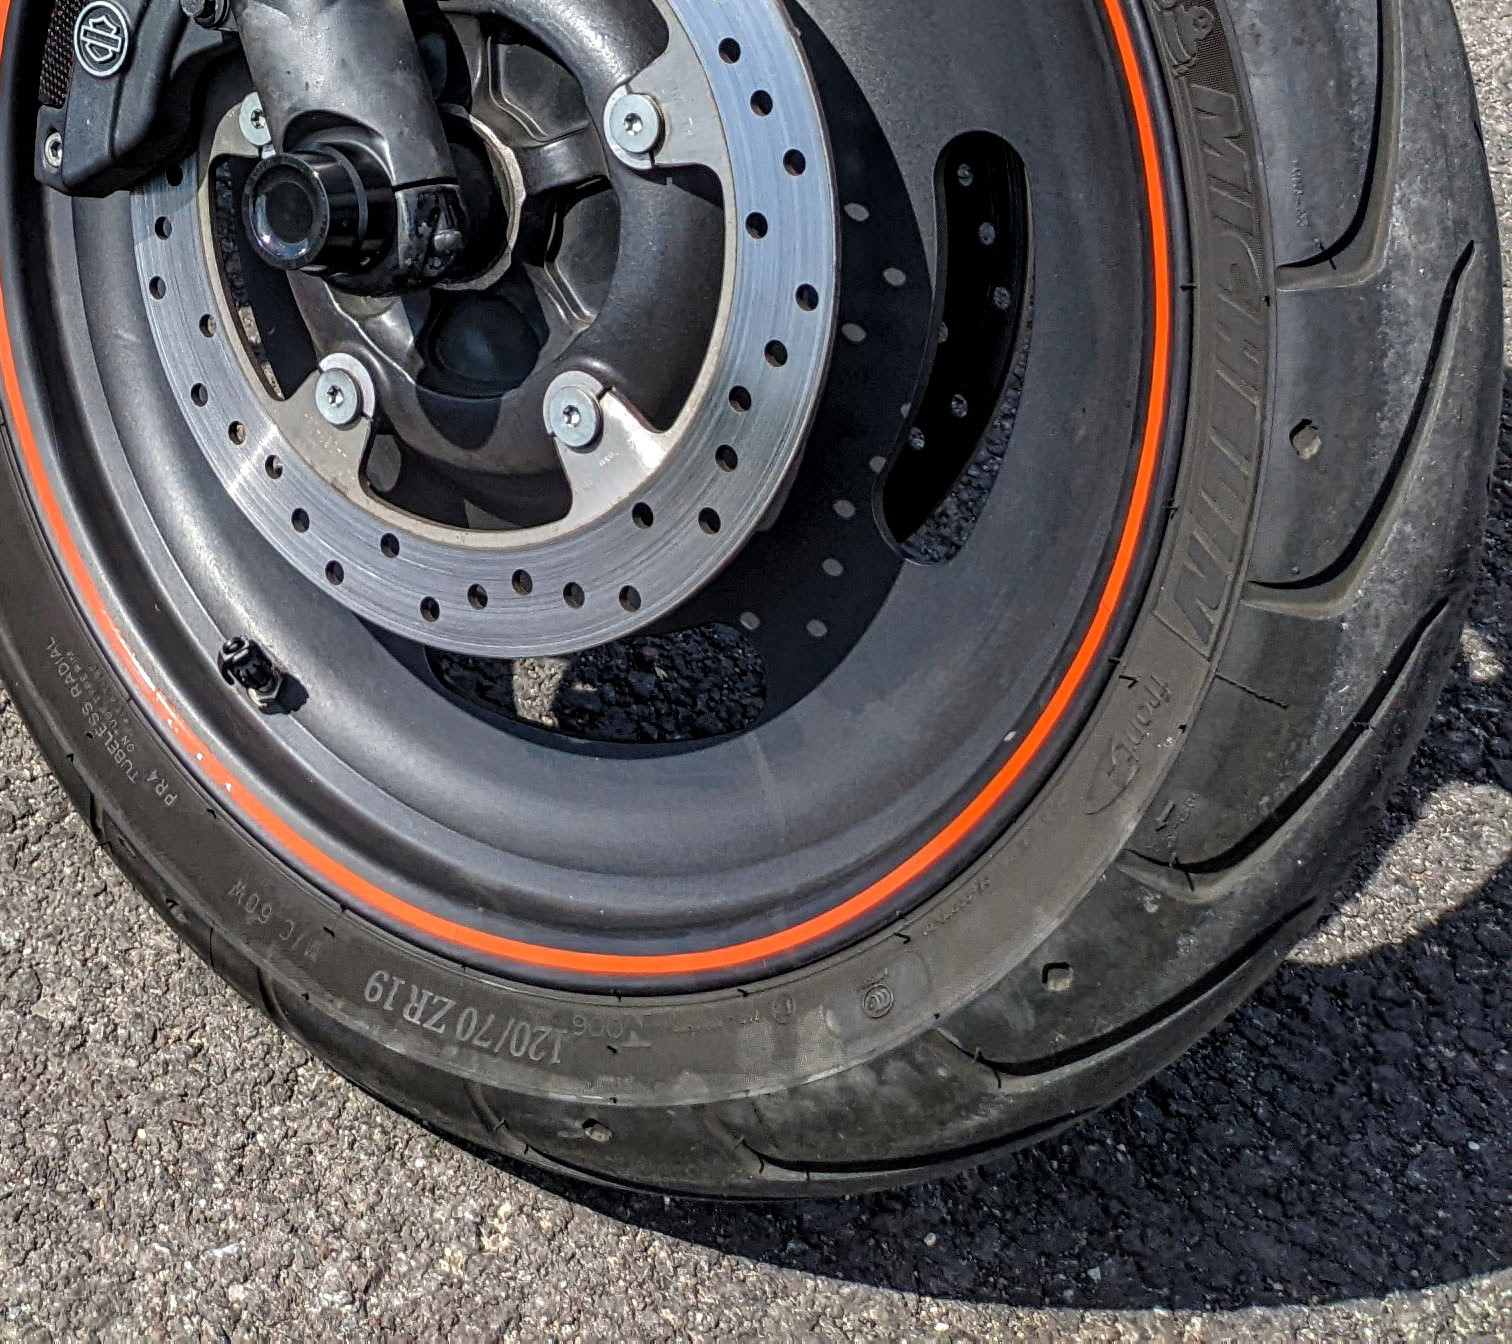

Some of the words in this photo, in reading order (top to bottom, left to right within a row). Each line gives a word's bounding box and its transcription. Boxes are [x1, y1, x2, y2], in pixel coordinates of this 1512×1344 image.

[46, 636, 83, 698] RADIAL
[81, 701, 139, 784] TUBELESS
[120, 735, 135, 753] ON
[455, 1007, 569, 1064] 120/70
